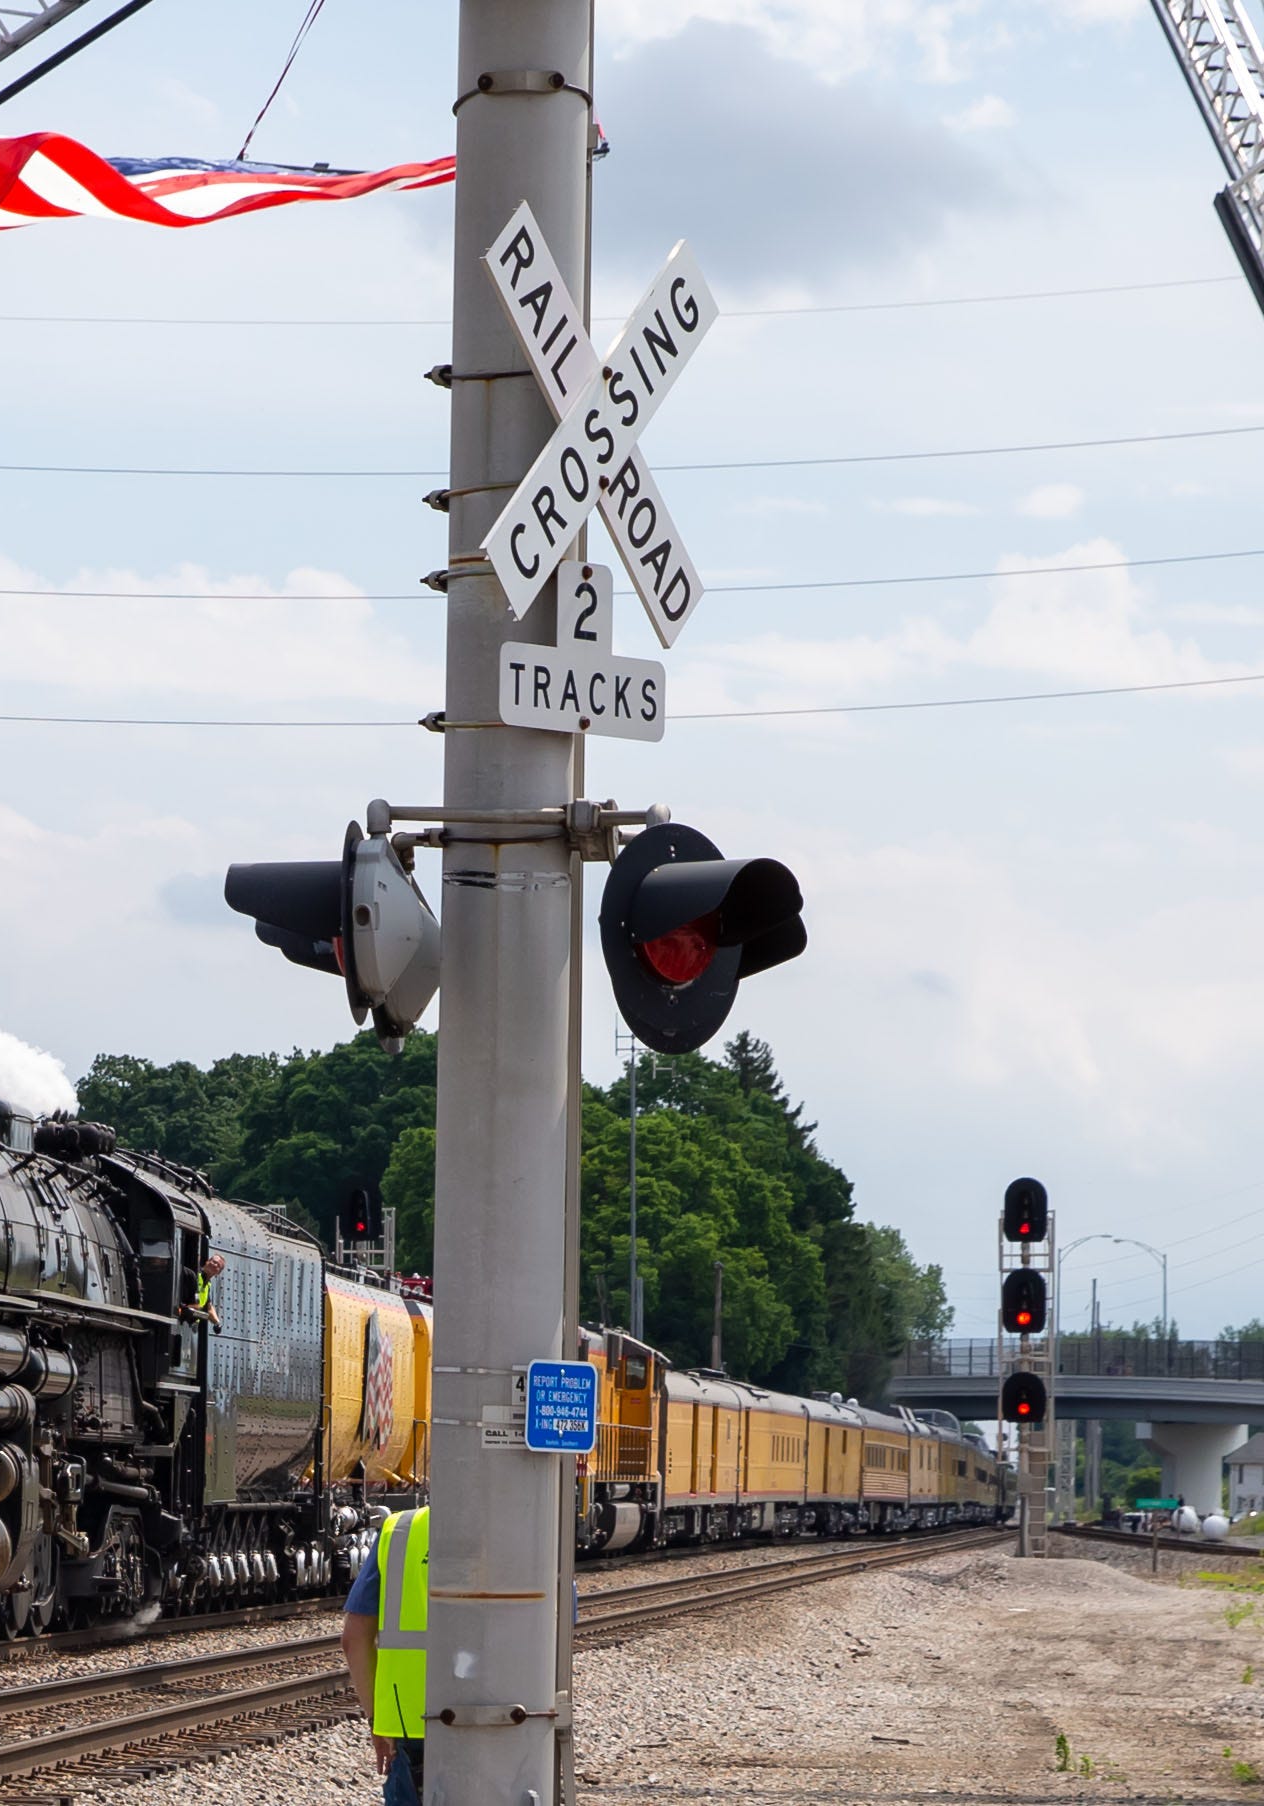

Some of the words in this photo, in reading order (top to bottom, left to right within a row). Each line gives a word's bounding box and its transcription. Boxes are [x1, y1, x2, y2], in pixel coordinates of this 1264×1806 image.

[499, 225, 578, 398] RAIL
[608, 456, 691, 622] ROAD
[510, 277, 700, 579] CROSSING
[573, 582, 598, 642] 2
[509, 662, 657, 722] TRACKS
[533, 1375, 558, 1388] REPORT
[561, 1376, 591, 1390] PROBLEM
[536, 1391, 546, 1402] OR
[548, 1391, 587, 1404] EMERGENCY
[484, 1429, 508, 1437] CALL
